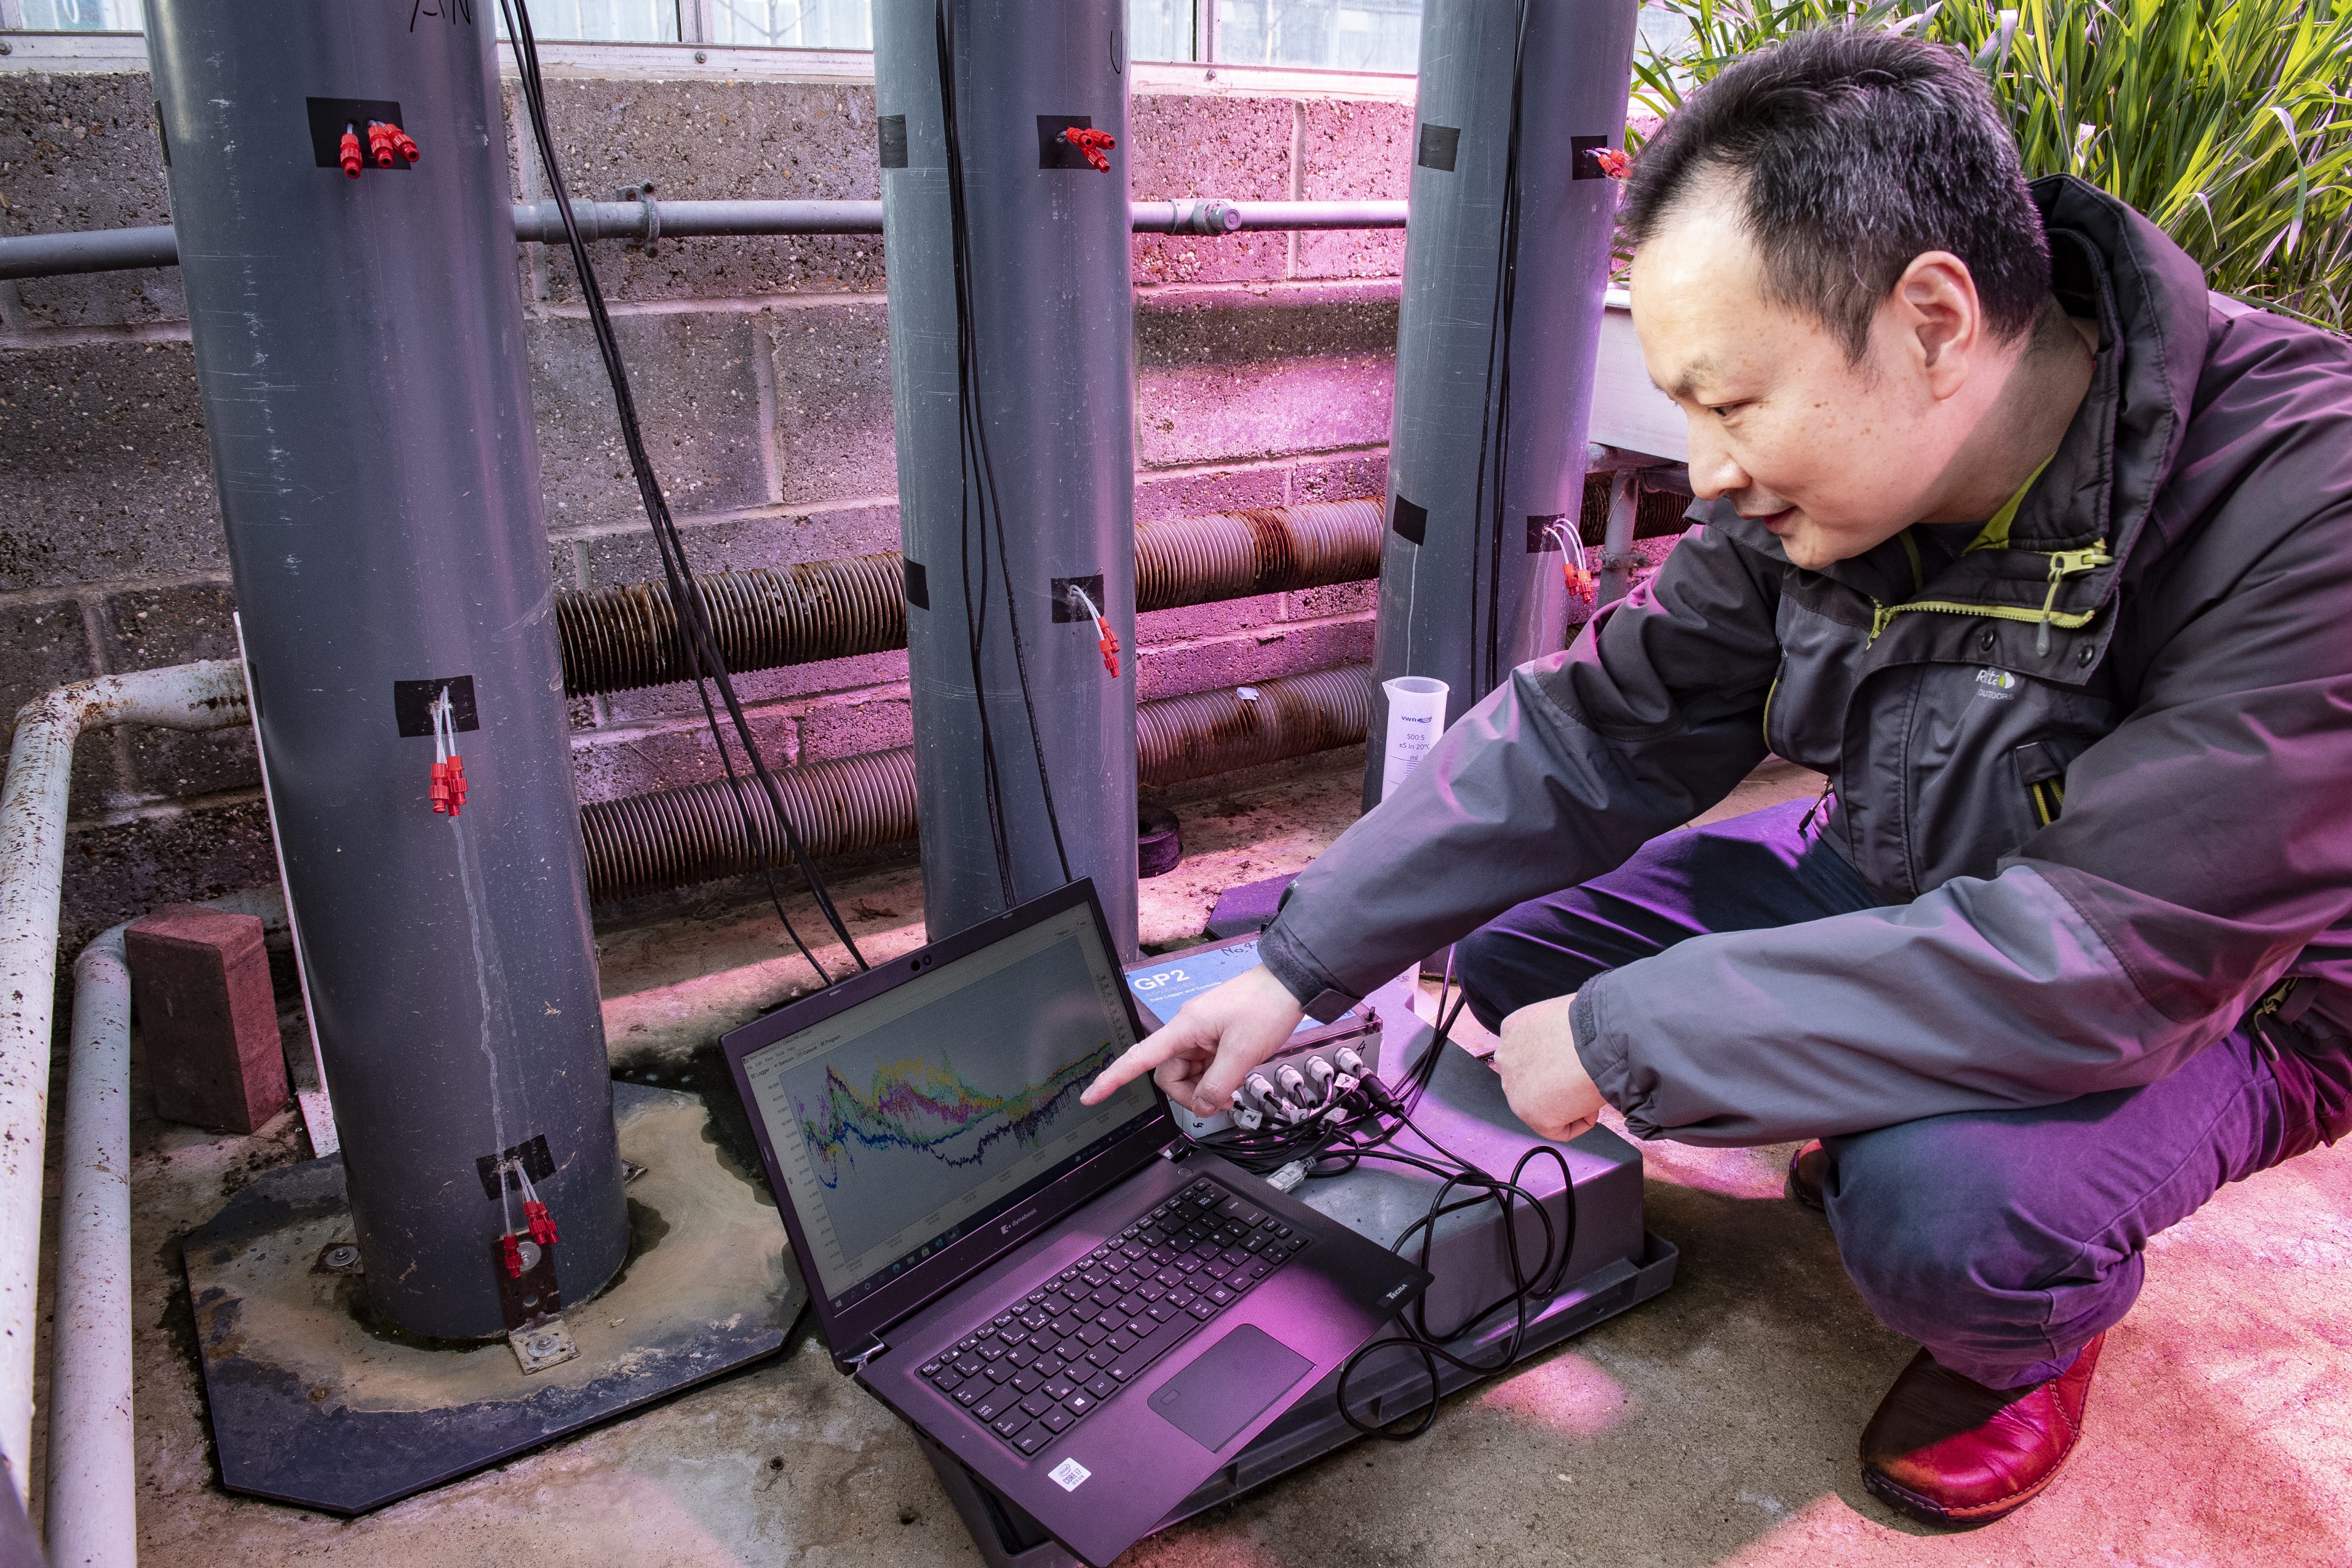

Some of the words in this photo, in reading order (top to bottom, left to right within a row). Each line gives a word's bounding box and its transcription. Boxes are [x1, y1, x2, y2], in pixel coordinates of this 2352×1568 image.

[1134, 969, 1190, 990] GP2
[1146, 981, 1196, 997] ADVANCED
[1164, 991, 1183, 999] Logger
[1356, 1040, 1365, 1056] 4
[1012, 1208, 1038, 1226] dynabook
[1062, 1472, 1077, 1484] CORE
